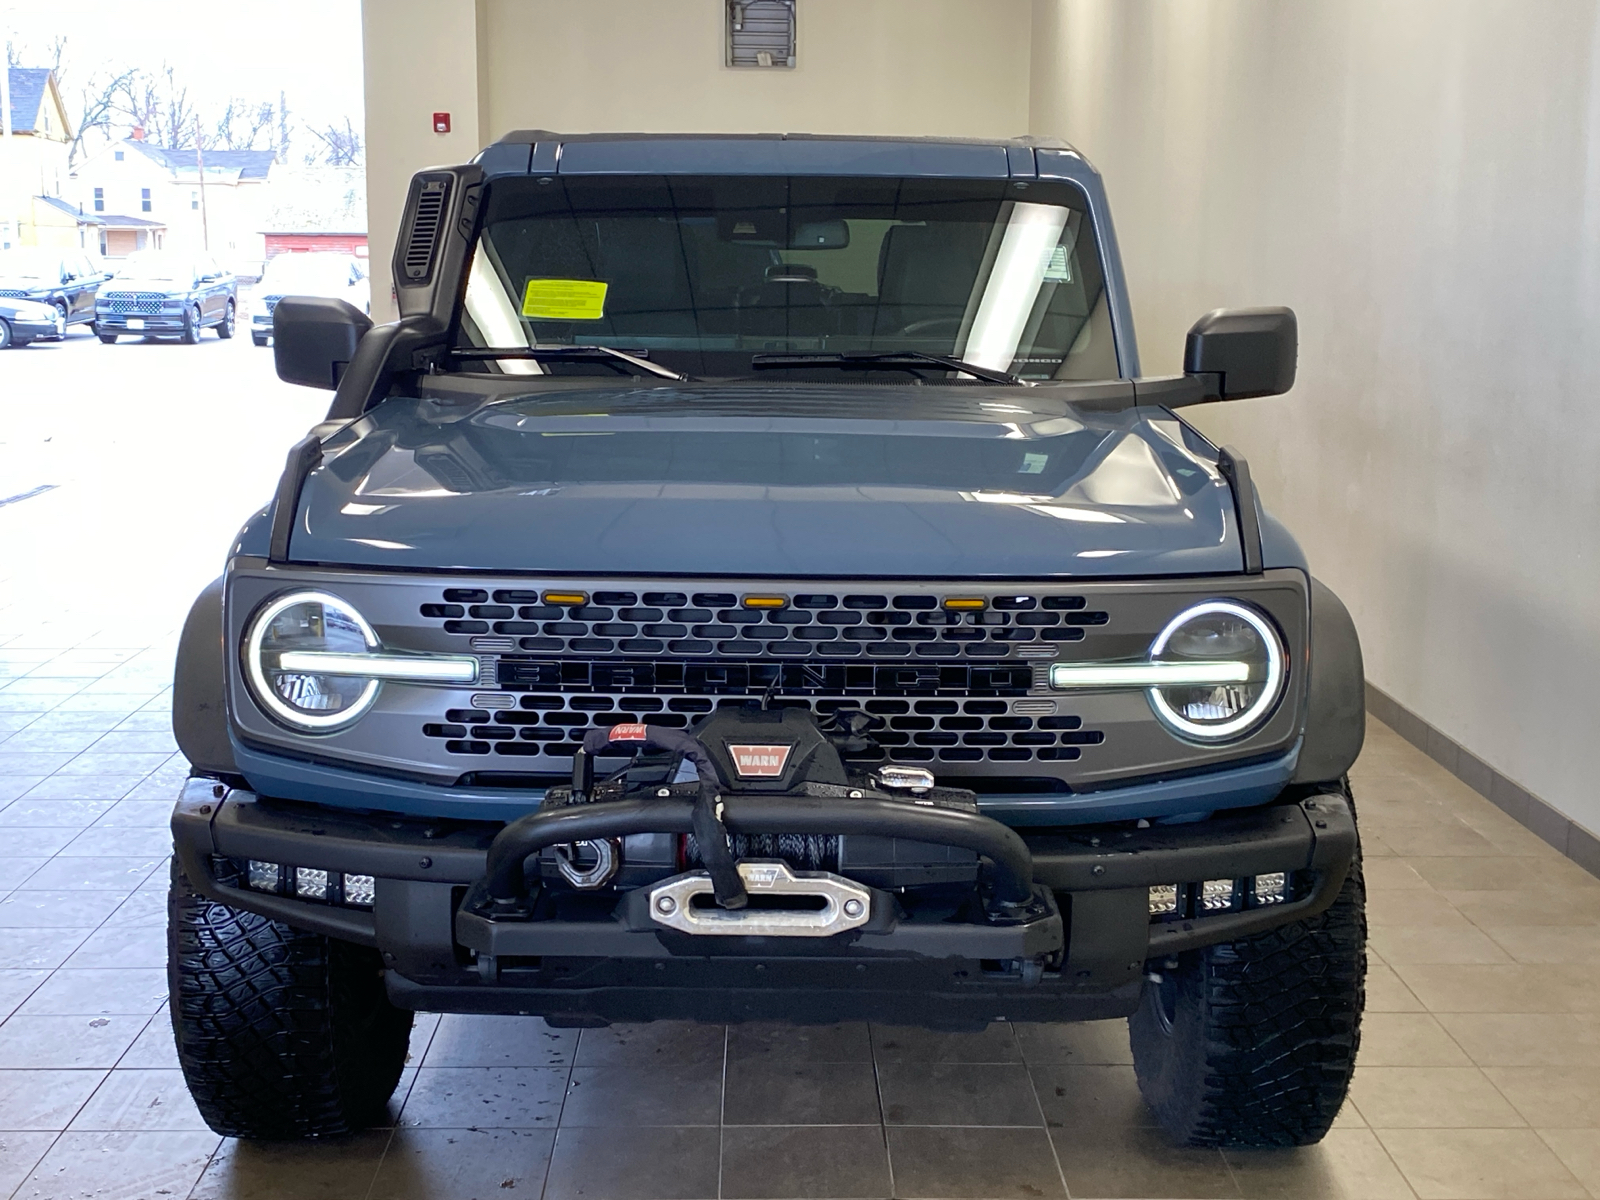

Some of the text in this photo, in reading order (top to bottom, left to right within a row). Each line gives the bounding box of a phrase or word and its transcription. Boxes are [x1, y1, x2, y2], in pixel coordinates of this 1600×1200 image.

[496, 660, 1032, 690] BRONCO
[614, 726, 642, 734] WARN
[739, 755, 779, 766] WARN
